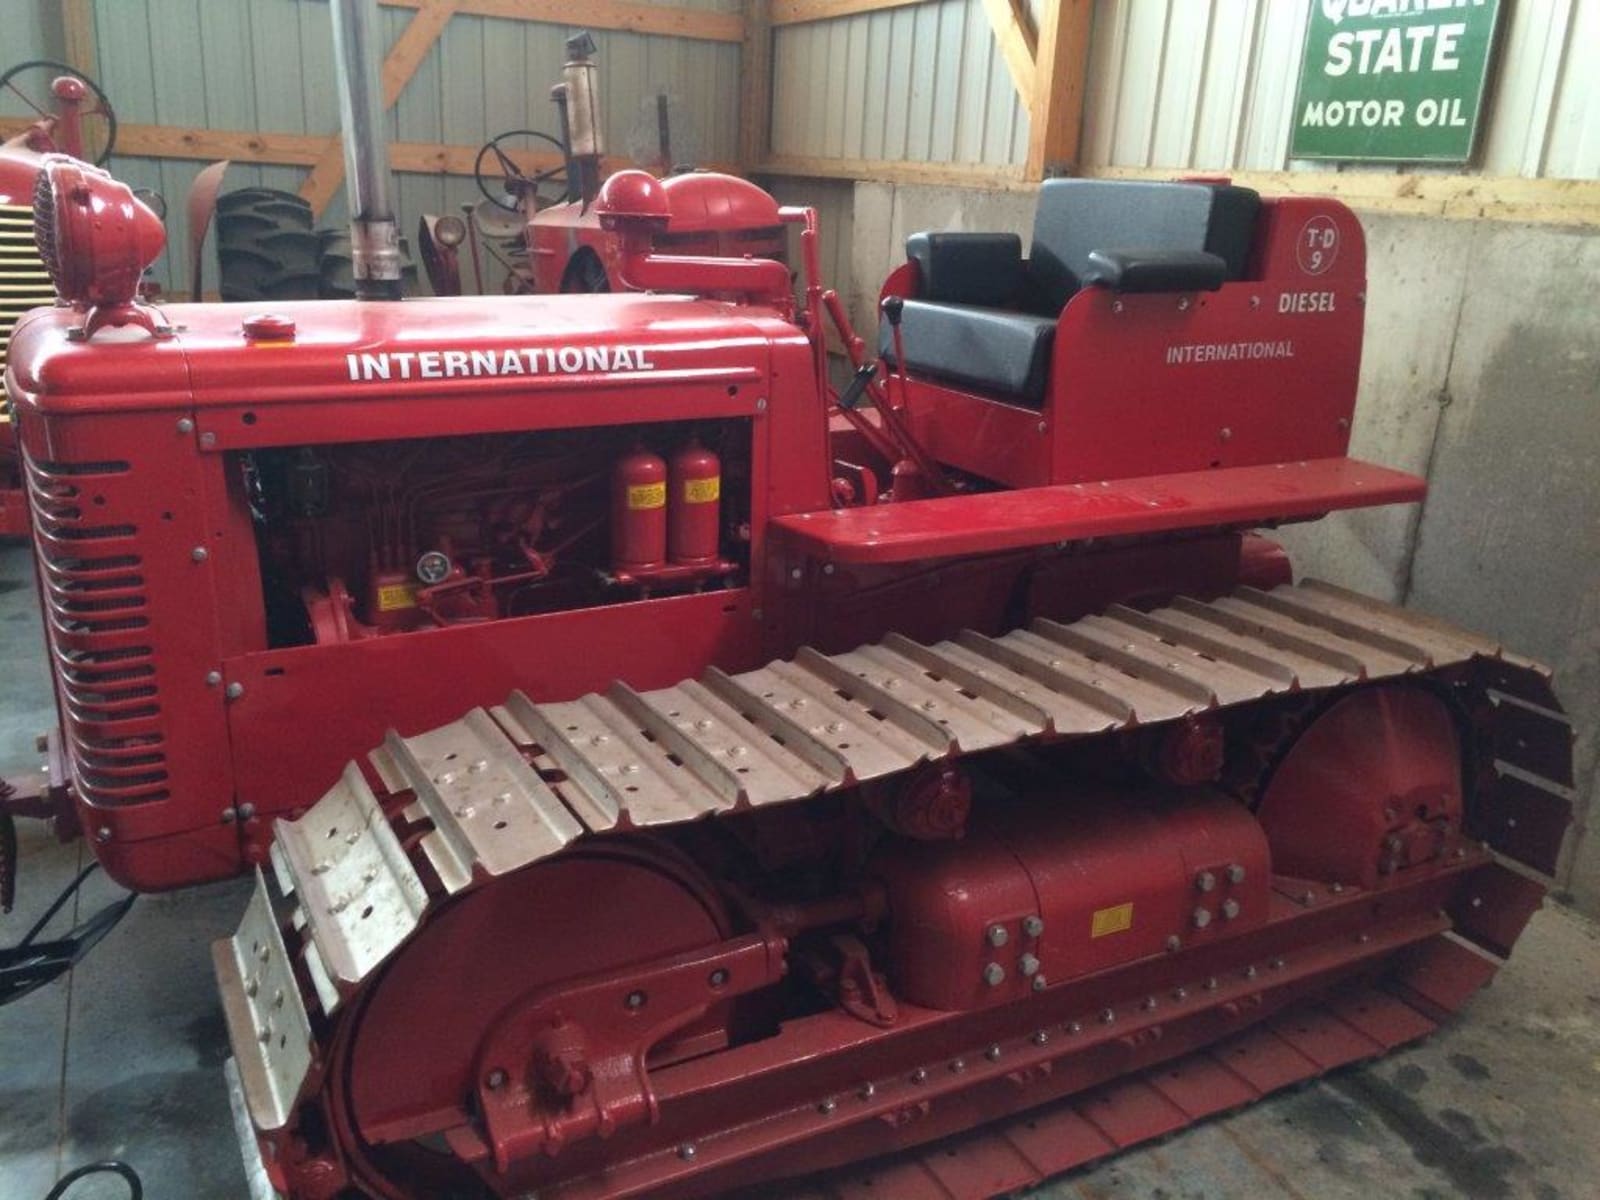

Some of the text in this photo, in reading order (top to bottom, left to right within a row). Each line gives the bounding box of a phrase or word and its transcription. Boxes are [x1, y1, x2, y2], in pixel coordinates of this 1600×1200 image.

[1324, 23, 1466, 76] STATE
[1302, 99, 1466, 127] MOTOR OIL
[1311, 251, 1322, 269] 9
[1278, 292, 1336, 313] DIESEL
[346, 345, 654, 380] INTERNATIONAL
[1166, 341, 1294, 363] INTERNATIONAL
